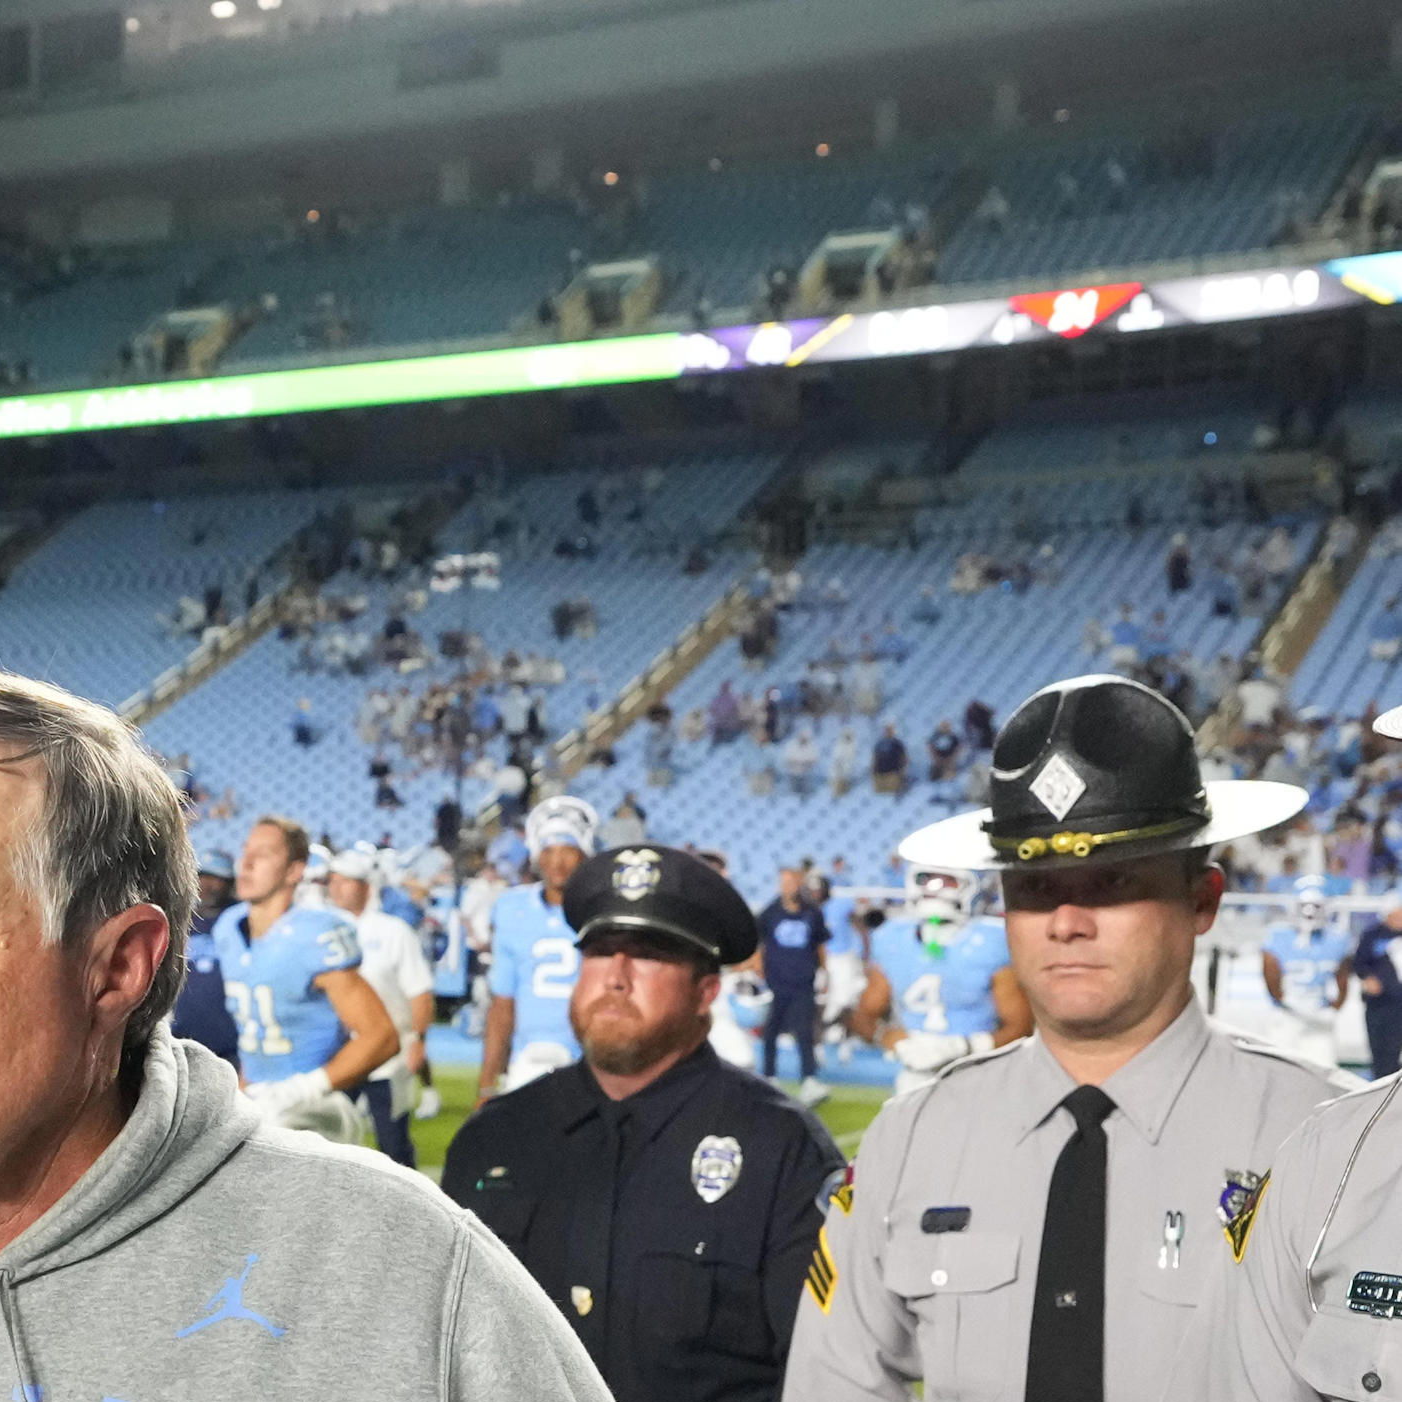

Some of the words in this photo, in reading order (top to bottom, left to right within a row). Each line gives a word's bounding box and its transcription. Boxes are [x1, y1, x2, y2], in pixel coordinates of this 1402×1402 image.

[82, 382, 253, 427] Athletics
[532, 937, 578, 999] 2
[904, 973, 948, 1031] 4
